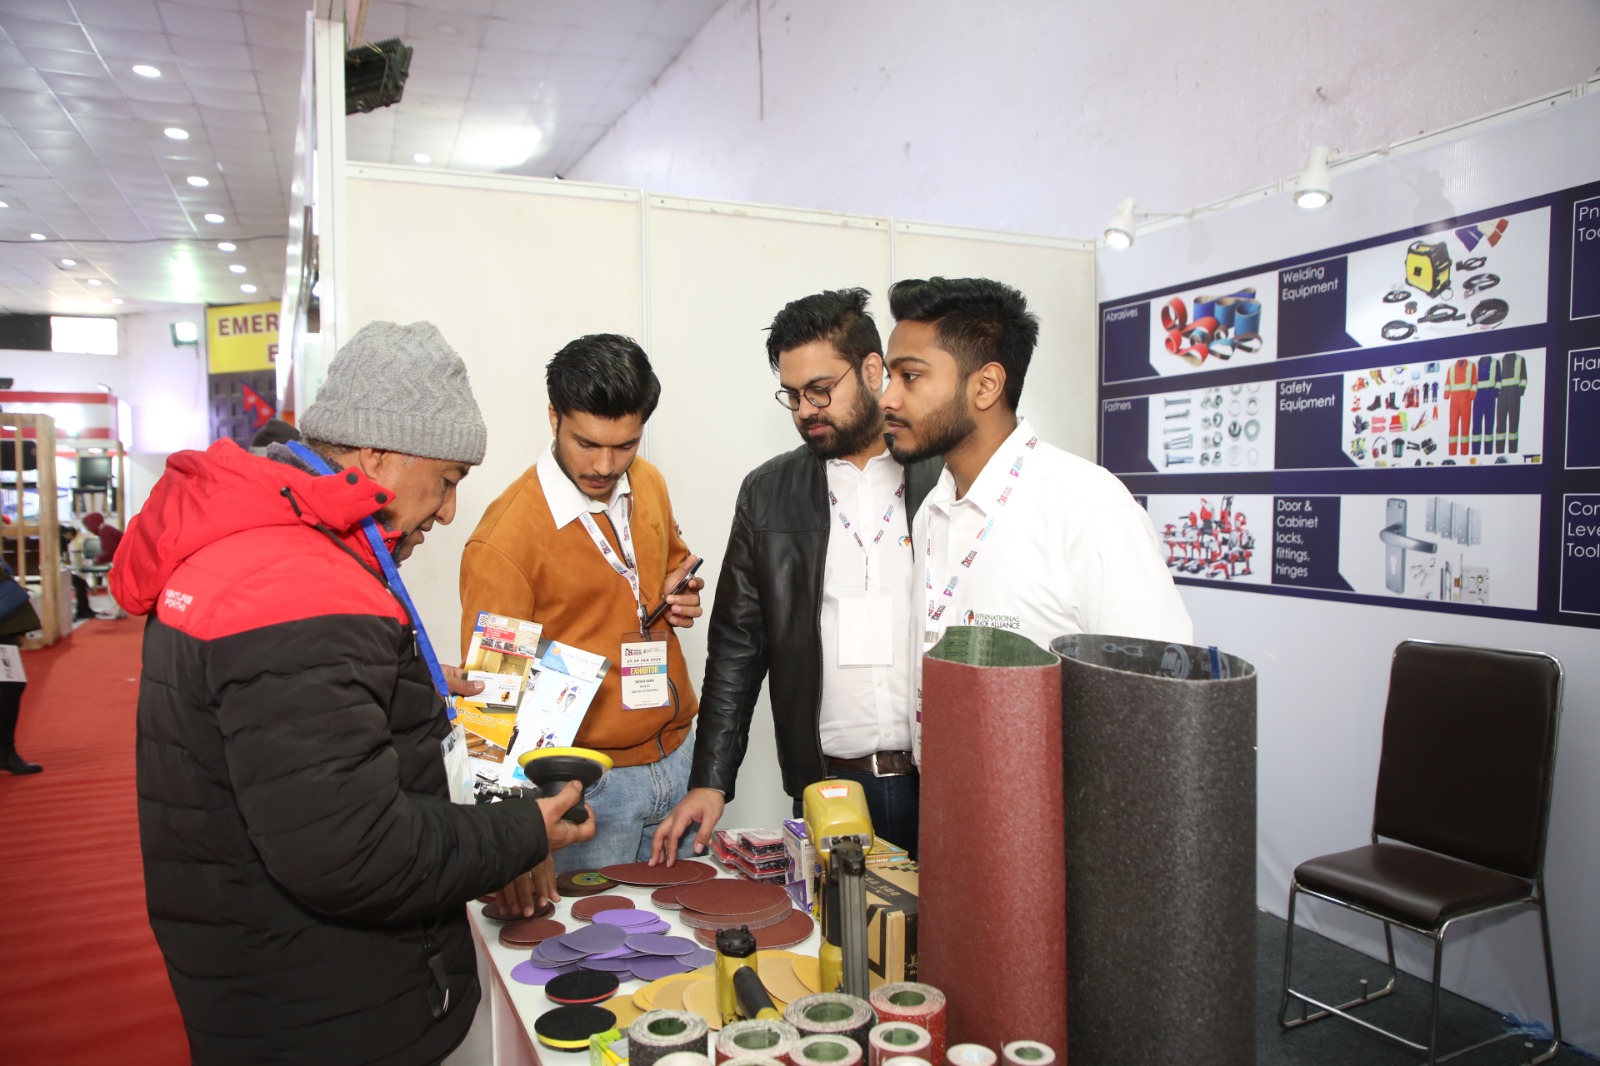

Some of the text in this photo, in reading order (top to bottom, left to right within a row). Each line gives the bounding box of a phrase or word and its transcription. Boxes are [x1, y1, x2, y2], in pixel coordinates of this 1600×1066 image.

[1282, 266, 1325, 284] Welding
[1282, 277, 1338, 301] Equipment
[218, 313, 279, 336] EMER
[1279, 380, 1312, 395] Safety
[1279, 394, 1335, 412] Equipment
[1276, 499, 1313, 512] Door &
[1276, 515, 1319, 528] Cabinet
[1275, 531, 1304, 545] locks,
[1275, 547, 1311, 563] fittings,
[1275, 563, 1309, 579] hinges
[974, 613, 1021, 623] INTERNATIONAL
[990, 621, 1021, 630] ALLIANCE
[630, 665, 659, 675] EXHIBITOR
